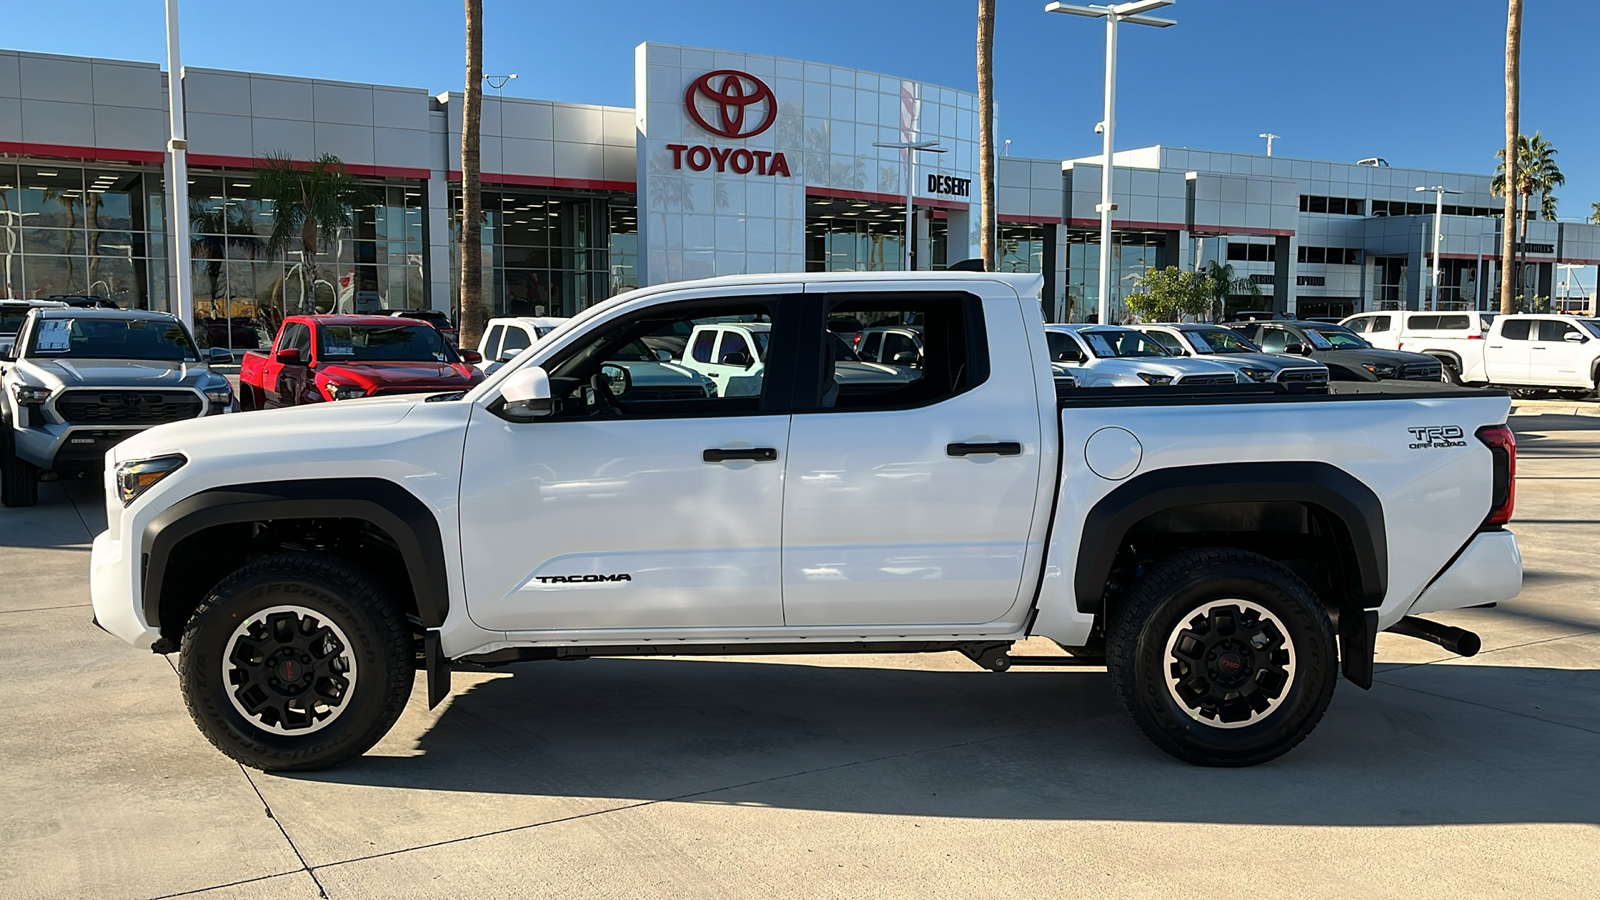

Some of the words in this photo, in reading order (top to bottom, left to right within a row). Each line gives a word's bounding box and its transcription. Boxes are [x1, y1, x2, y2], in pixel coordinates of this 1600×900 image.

[666, 144, 791, 177] TOYOTA
[928, 174, 971, 197] DESERT
[1407, 425, 1464, 443] TRD
[535, 574, 632, 583] TACOMA
